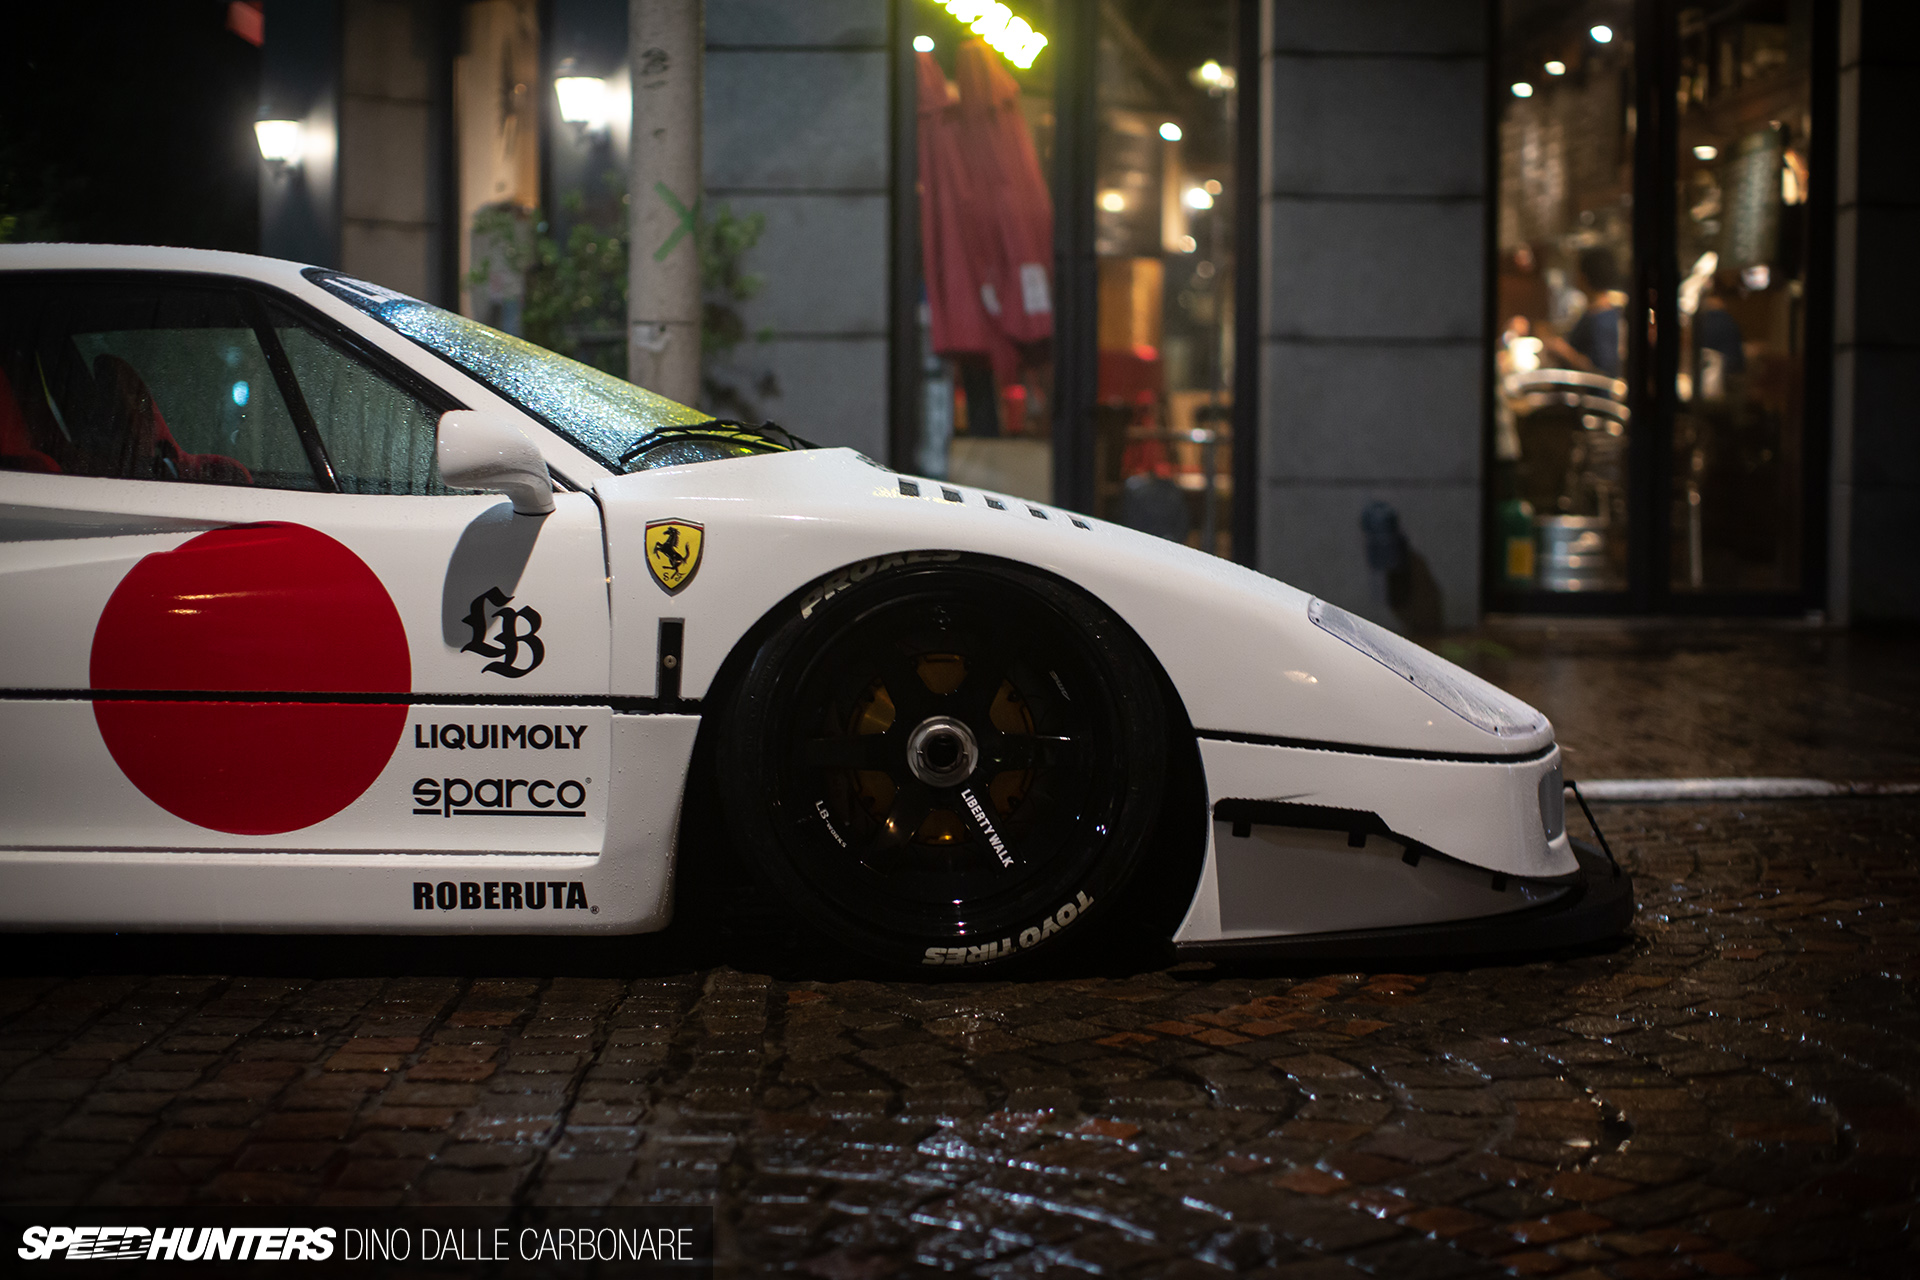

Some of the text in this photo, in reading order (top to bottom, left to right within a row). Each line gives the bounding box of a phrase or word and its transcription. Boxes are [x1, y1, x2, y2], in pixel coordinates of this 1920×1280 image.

[960, 788, 1014, 868] LIBERTY WALK
[922, 890, 1095, 965] TOYO TIRES
